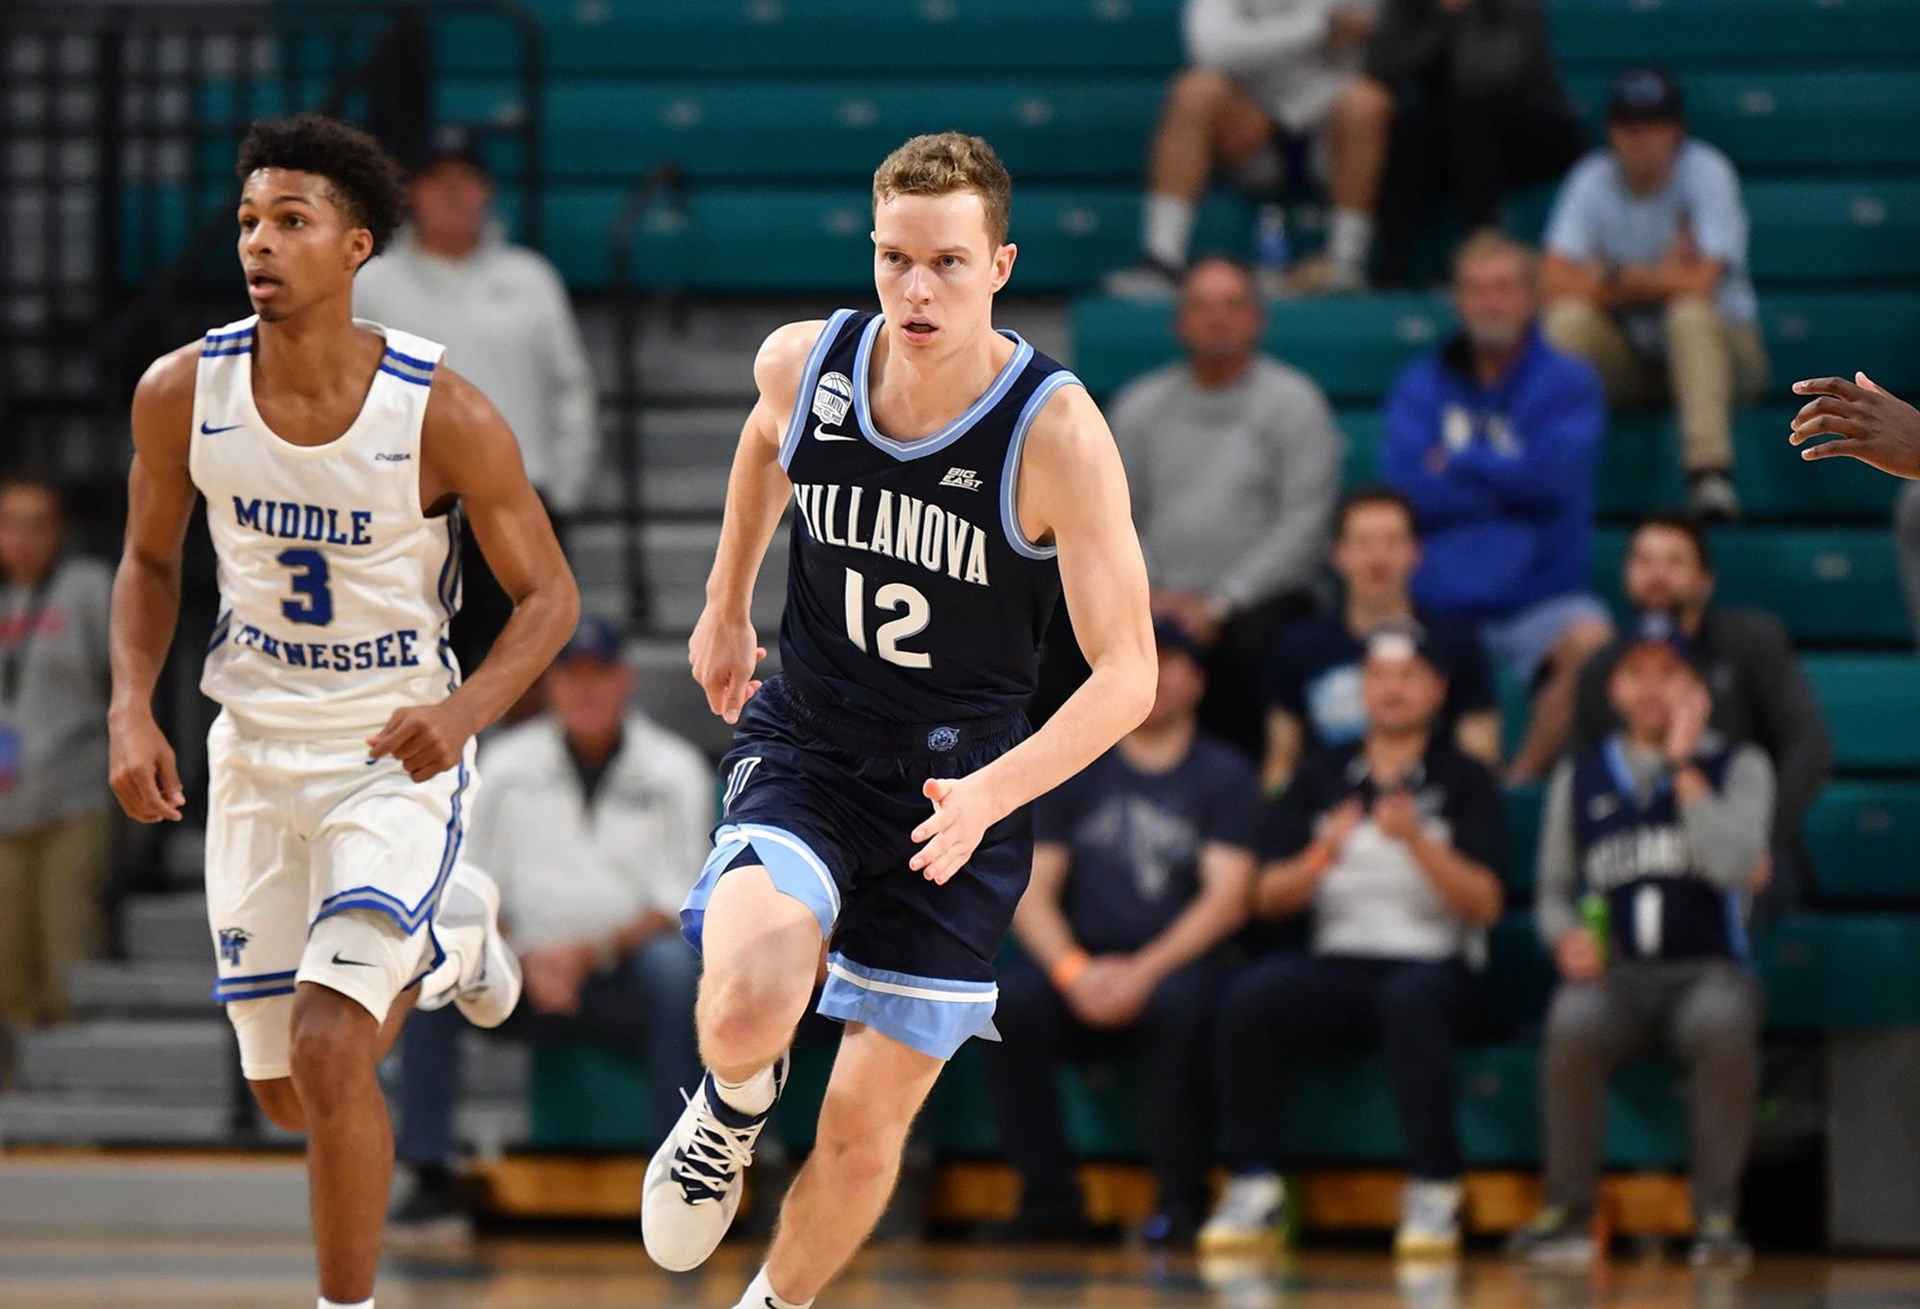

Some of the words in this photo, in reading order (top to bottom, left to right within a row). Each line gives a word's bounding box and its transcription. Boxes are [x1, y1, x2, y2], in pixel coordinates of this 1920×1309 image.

[942, 474, 984, 489] EAST
[947, 467, 978, 479] BIG
[232, 496, 372, 546] MIDDLE
[793, 483, 991, 587] VILLANOVA
[277, 548, 334, 627] 3
[844, 566, 933, 669] 12
[235, 625, 420, 672] TNNESSEE
